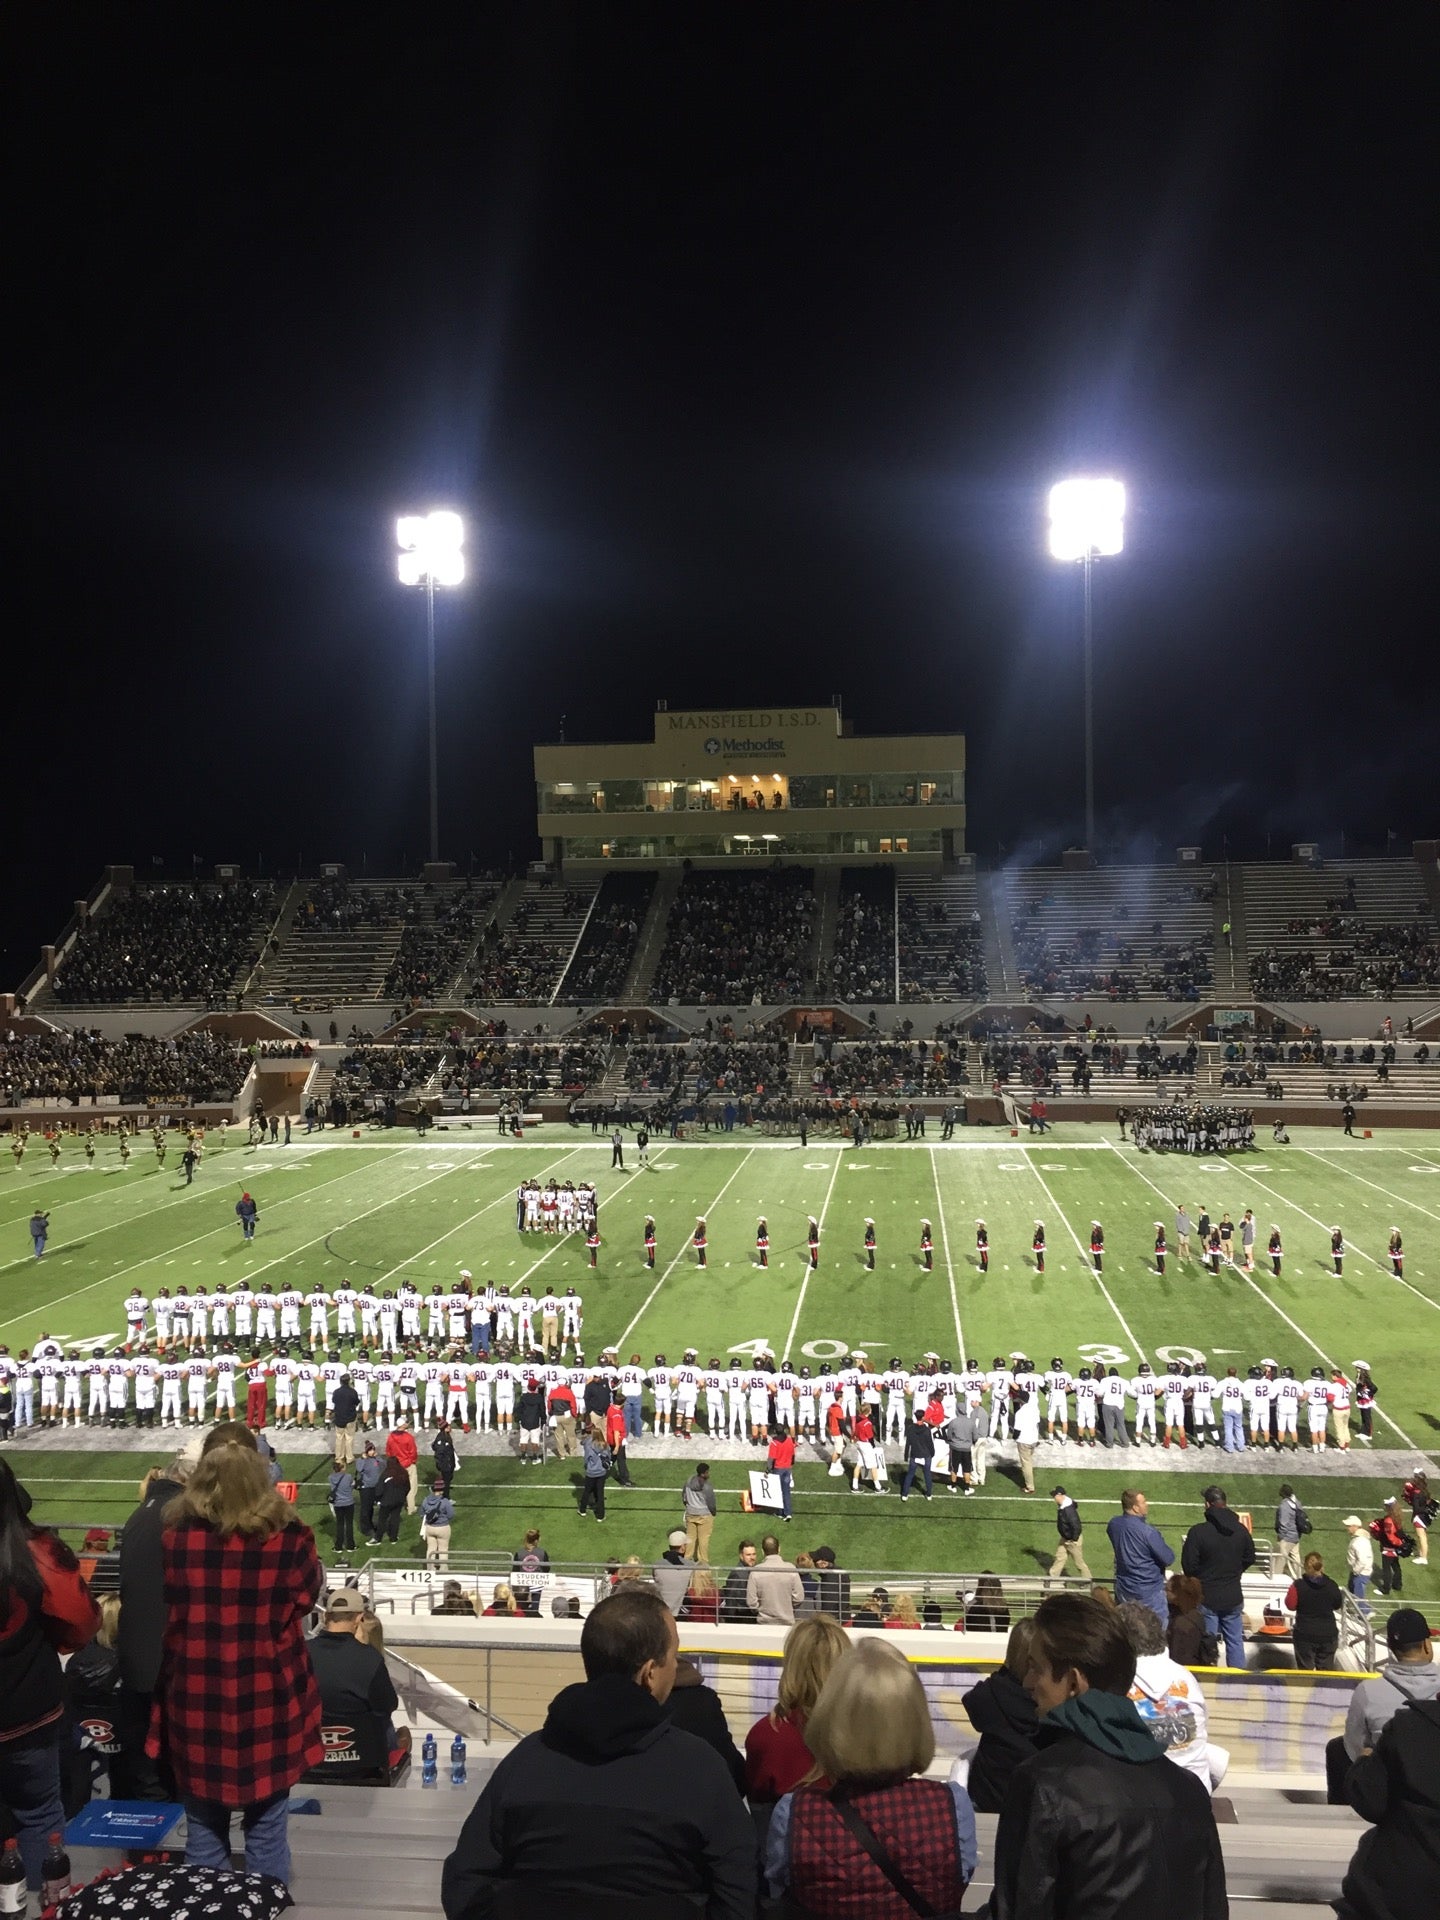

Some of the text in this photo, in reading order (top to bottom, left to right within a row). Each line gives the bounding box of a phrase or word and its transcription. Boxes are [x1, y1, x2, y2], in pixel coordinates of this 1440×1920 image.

[669, 712, 822, 730] MANSFIELD I.S.D.
[723, 738, 785, 750] Methodist
[40, 1366, 53, 1376] 33
[64, 1366, 77, 1376] 24
[136, 1364, 149, 1375] 75
[189, 1365, 203, 1375] 38
[218, 1361, 231, 1372] 88
[275, 1364, 287, 1375] 48
[16, 1368, 28, 1378] 32
[164, 1369, 178, 1380] 32
[299, 1370, 311, 1380] 43
[352, 1369, 366, 1380] 22
[377, 1370, 391, 1381] 35
[401, 1367, 414, 1379] 27
[427, 1368, 438, 1379] 17
[496, 1369, 509, 1379] 94
[522, 1369, 535, 1380] 25
[545, 1370, 558, 1382] 13
[572, 1373, 585, 1383] 37
[624, 1372, 638, 1384] 64
[656, 1373, 667, 1385] 18
[680, 1372, 693, 1383] 70
[706, 1377, 720, 1388] 39
[732, 1377, 739, 1388] 9
[751, 1377, 764, 1389] 65
[779, 1378, 792, 1390] 40
[825, 1381, 836, 1393] 81
[890, 1379, 904, 1390] 40
[918, 1381, 929, 1392] 21
[967, 1380, 982, 1391] 35
[998, 1378, 1005, 1390] 7
[1025, 1381, 1036, 1393] 41
[1054, 1378, 1066, 1390] 12
[1110, 1382, 1123, 1395] 61
[1168, 1381, 1182, 1393] 90
[1198, 1381, 1210, 1393] 16
[802, 1385, 813, 1397] 31
[1080, 1385, 1094, 1398] 75
[1142, 1383, 1153, 1395] 10
[1226, 1386, 1240, 1398] 58
[1256, 1385, 1269, 1397] 62
[1283, 1385, 1297, 1397] 60
[1314, 1387, 1328, 1398] 50
[761, 1479, 772, 1499] R
[410, 1571, 432, 1583] 112
